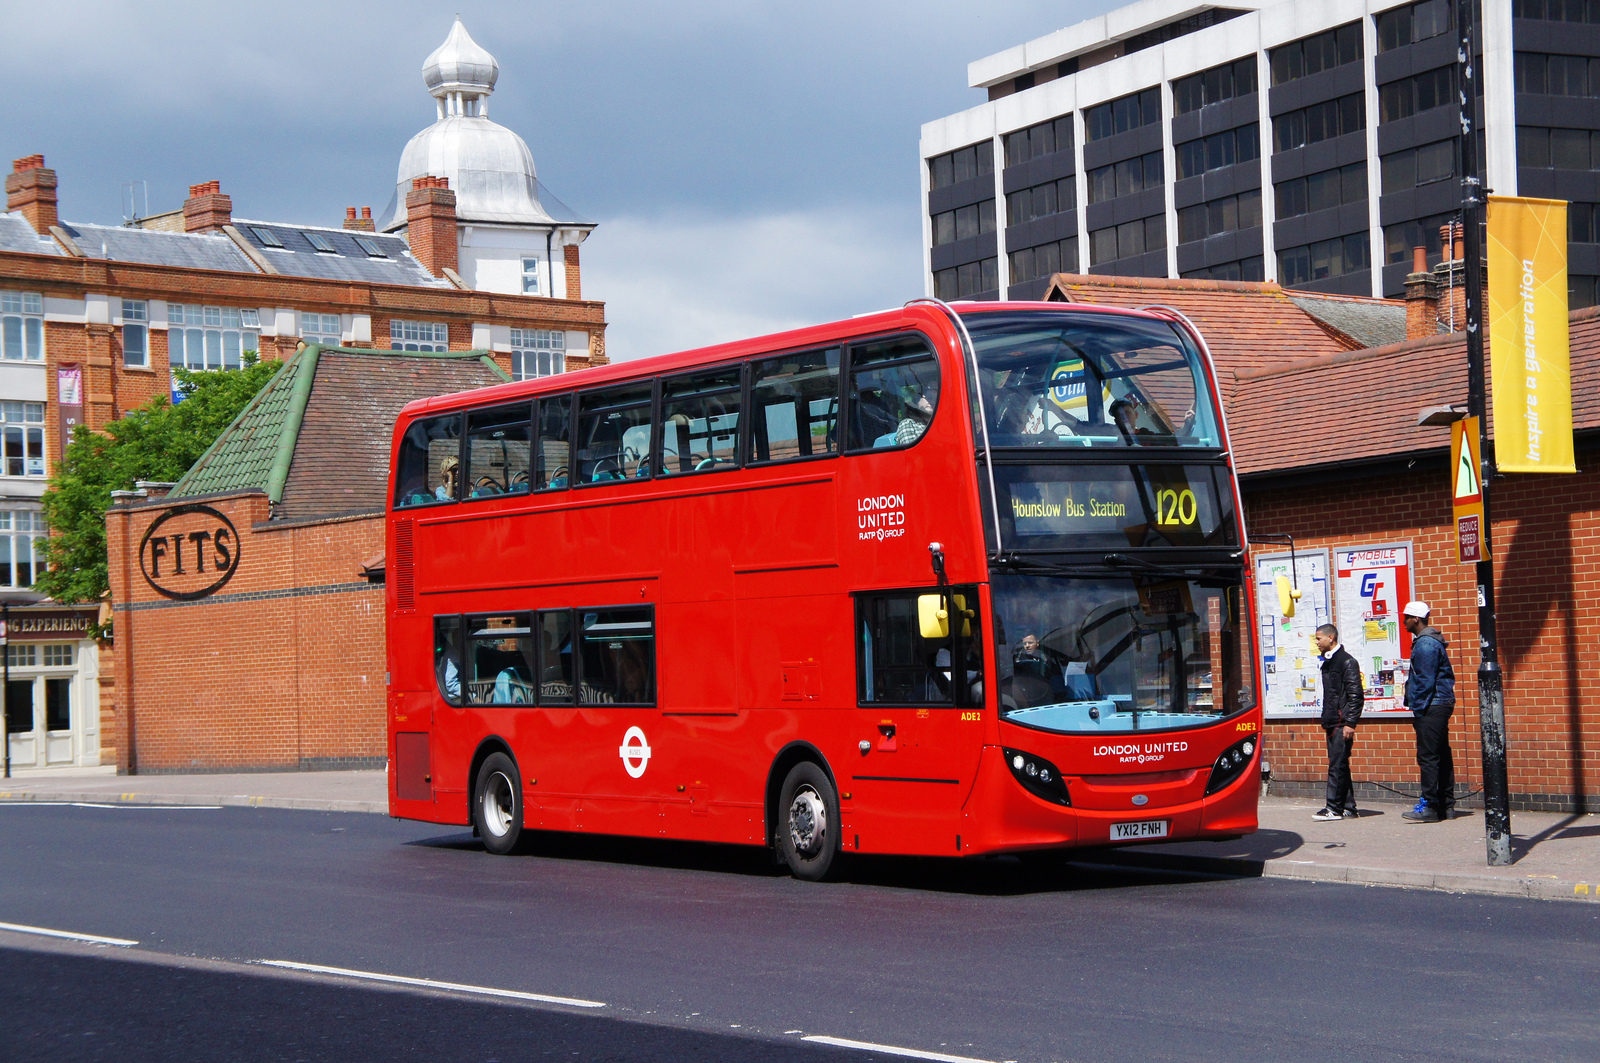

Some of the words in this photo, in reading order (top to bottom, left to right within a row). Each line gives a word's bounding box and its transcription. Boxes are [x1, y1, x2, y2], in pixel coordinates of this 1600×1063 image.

[1519, 259, 1541, 372] generation
[1526, 377, 1537, 389] a
[1524, 395, 1543, 461] Inspire
[857, 494, 904, 511] LONDON
[1011, 499, 1061, 517] Hounslow
[1066, 499, 1085, 517] Bus
[1090, 498, 1126, 517] Station
[1156, 489, 1197, 525] 120
[858, 511, 905, 528] UNITED
[1459, 520, 1477, 532] REDUCE
[858, 531, 876, 540] RATP
[884, 528, 905, 538] GROUP
[1461, 533, 1476, 545] SPEED
[149, 528, 230, 578] FITS
[1357, 549, 1397, 560] MOBILE
[1463, 546, 1475, 556] NOW
[22, 618, 91, 632] EXPERIENCE
[961, 712, 981, 721] ADE2
[1235, 722, 1256, 731] ADE2
[1093, 744, 1140, 756] LONDON
[1144, 742, 1188, 753] UNITED
[1116, 824, 1139, 837] YX12
[1141, 822, 1161, 835] FNH
